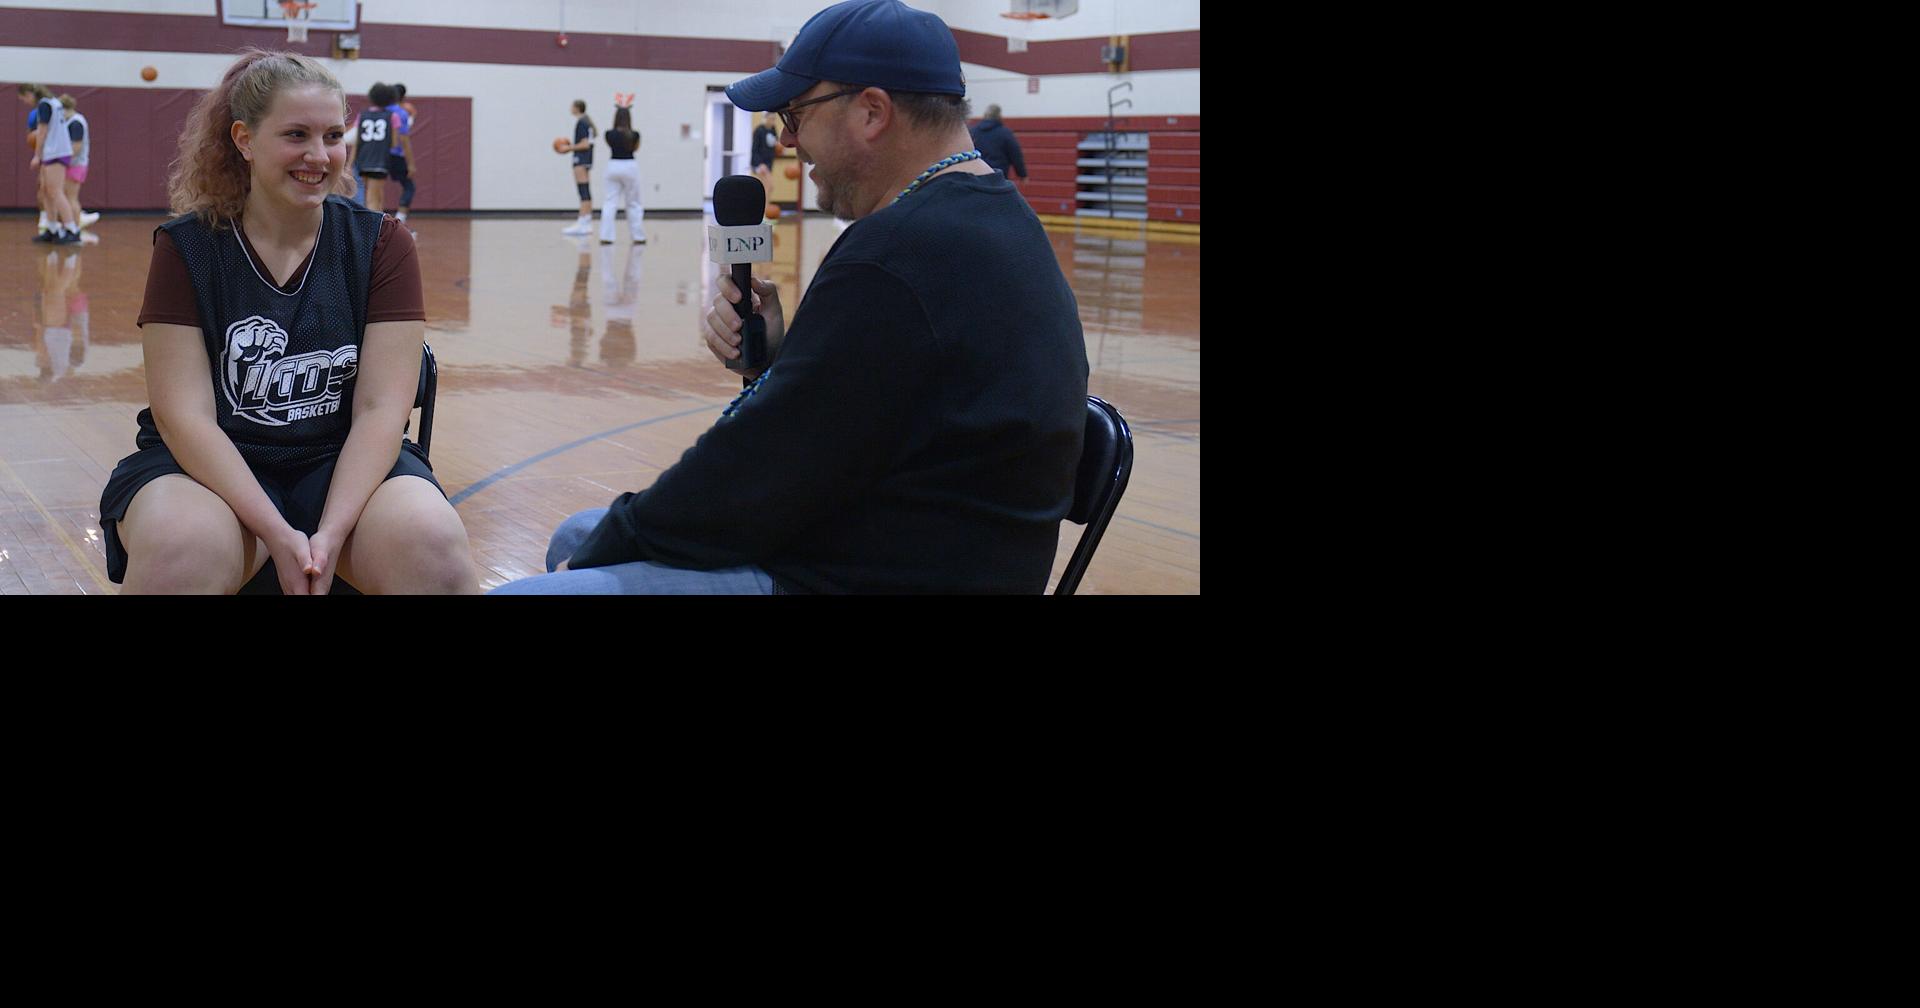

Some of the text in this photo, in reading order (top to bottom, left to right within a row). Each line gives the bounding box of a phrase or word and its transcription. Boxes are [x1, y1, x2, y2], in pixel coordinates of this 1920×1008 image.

[361, 118, 387, 142] 33
[727, 236, 764, 252] LNP
[238, 345, 358, 410] LCDS
[287, 400, 340, 422] BASKETB
